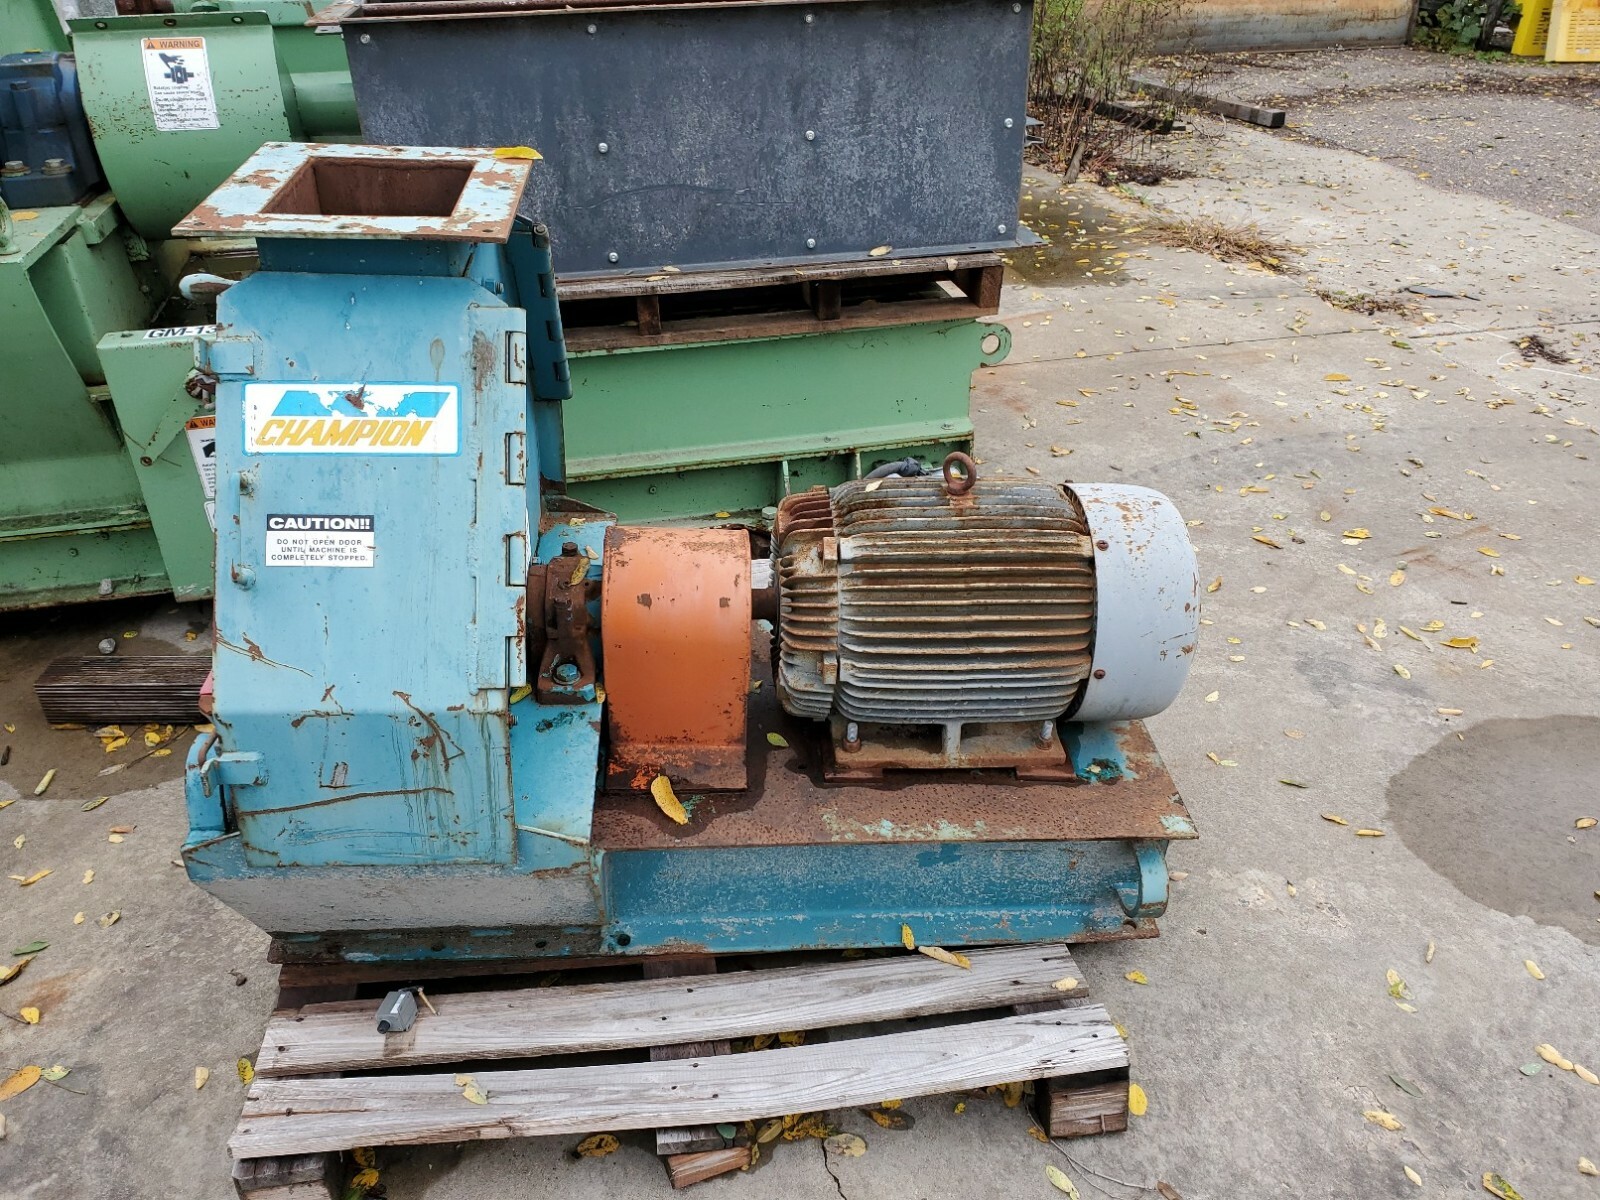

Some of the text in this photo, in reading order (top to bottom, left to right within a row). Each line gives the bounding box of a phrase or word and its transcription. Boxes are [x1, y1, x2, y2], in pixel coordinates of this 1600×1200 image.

[160, 40, 200, 48] WARNING
[254, 419, 433, 446] CHAMPION
[269, 517, 371, 530] CAUTION!!
